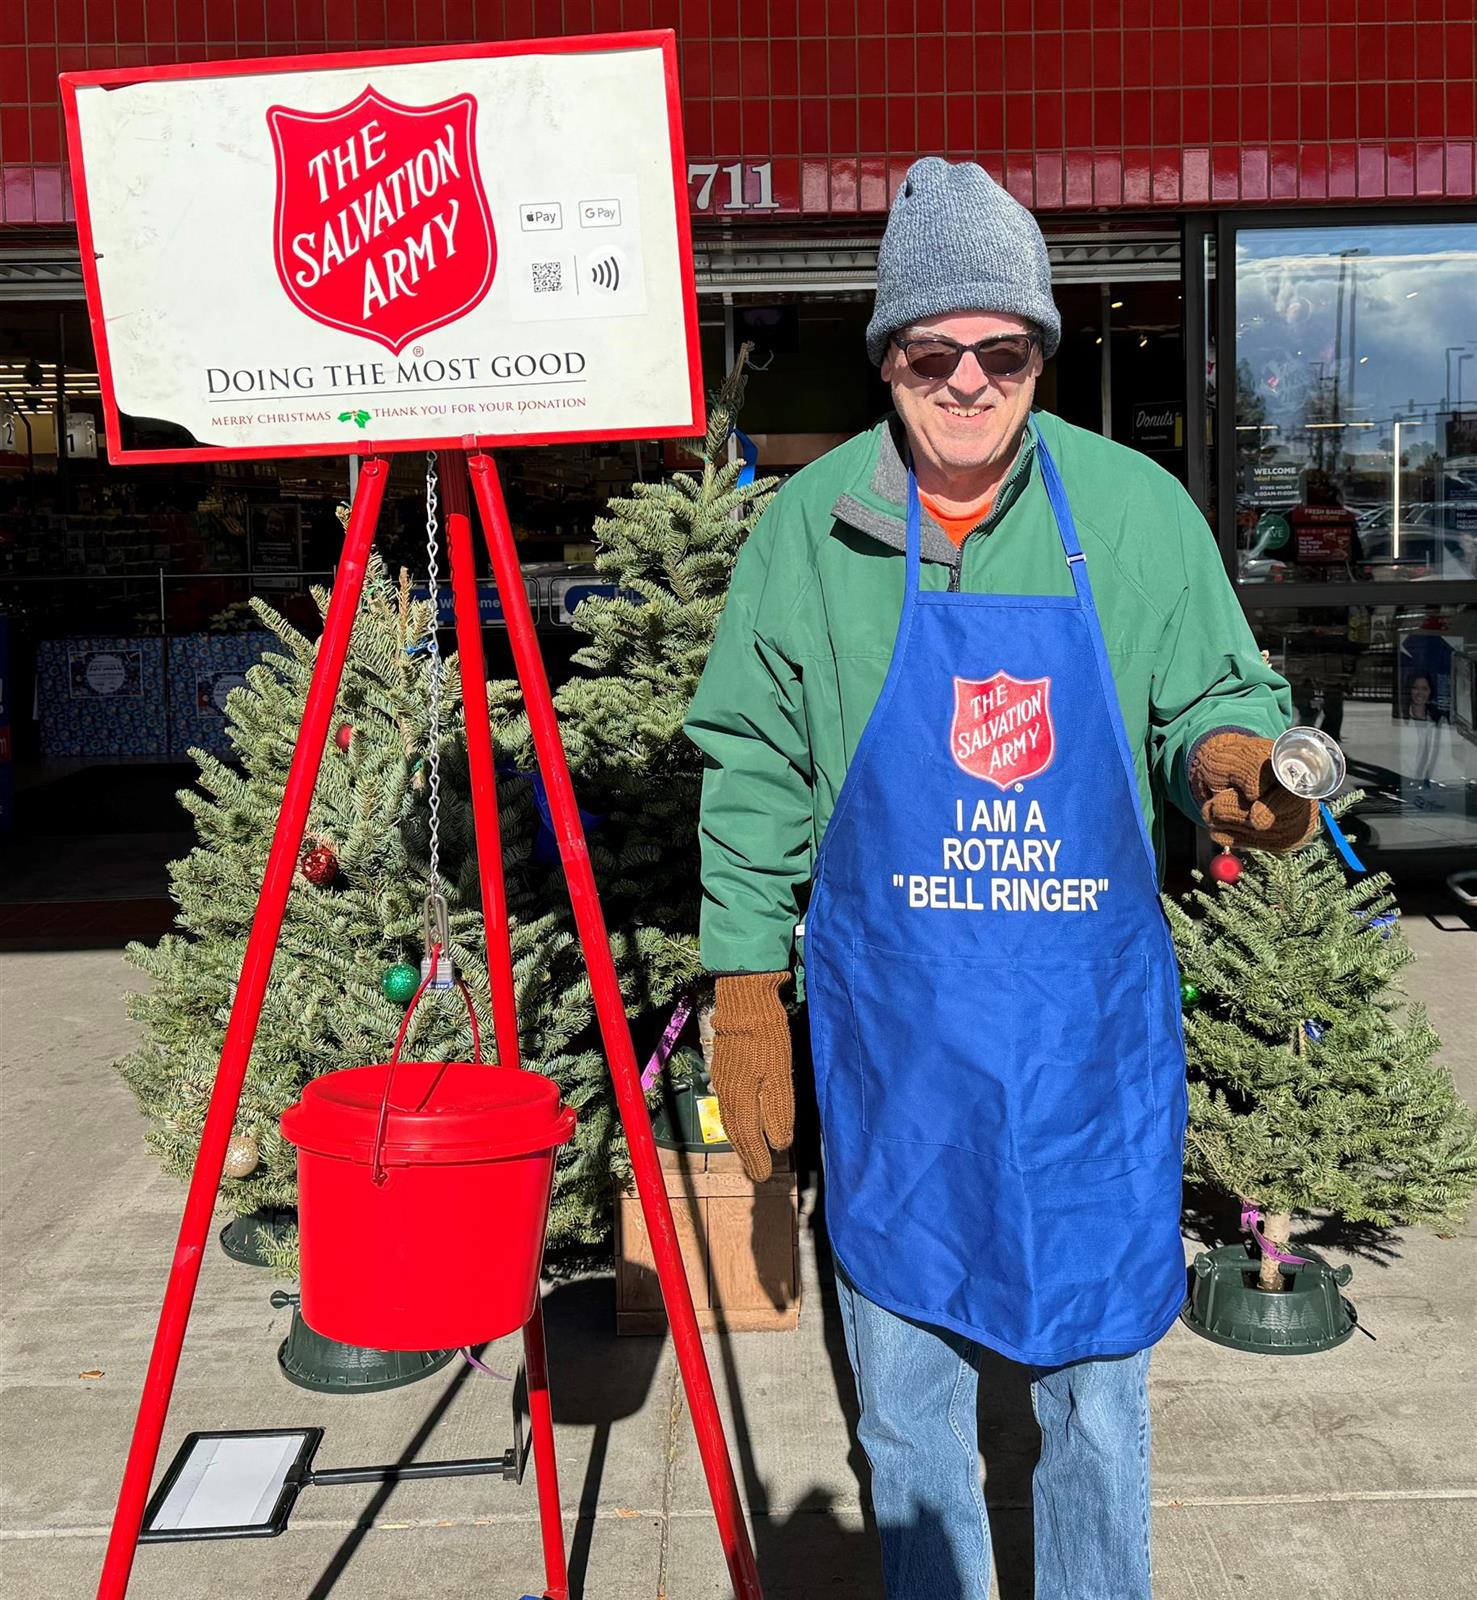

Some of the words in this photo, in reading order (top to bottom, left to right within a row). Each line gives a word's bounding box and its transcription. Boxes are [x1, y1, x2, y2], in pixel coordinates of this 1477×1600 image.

[308, 119, 387, 204] THE
[687, 162, 780, 210] 711
[292, 124, 461, 288] SALVATION
[535, 210, 556, 224] Pay
[597, 207, 616, 220] Pay
[362, 198, 460, 320] ARMY
[206, 366, 315, 394] DOING
[323, 363, 386, 388] THE
[396, 357, 480, 384] MOST
[491, 352, 586, 378] GOOD
[211, 415, 254, 426] MERRY
[257, 411, 332, 424] CHRISTMAS
[372, 406, 418, 418] THANK
[421, 403, 447, 416] YOU
[451, 402, 477, 414] FOR
[478, 400, 514, 413] YOUR
[518, 397, 587, 414] DONATION
[1136, 410, 1174, 428] Donuts
[1253, 467, 1297, 476] WELCOME
[970, 683, 1008, 720] THE
[957, 689, 1042, 759] SALVATION
[988, 722, 1040, 775] ARMY
[956, 799, 963, 832] I
[971, 799, 1016, 832] AM
[1024, 800, 1046, 832] A
[943, 837, 1061, 872] ROTARY
[893, 874, 984, 911] "BELL
[991, 878, 1109, 912] RINGER"
